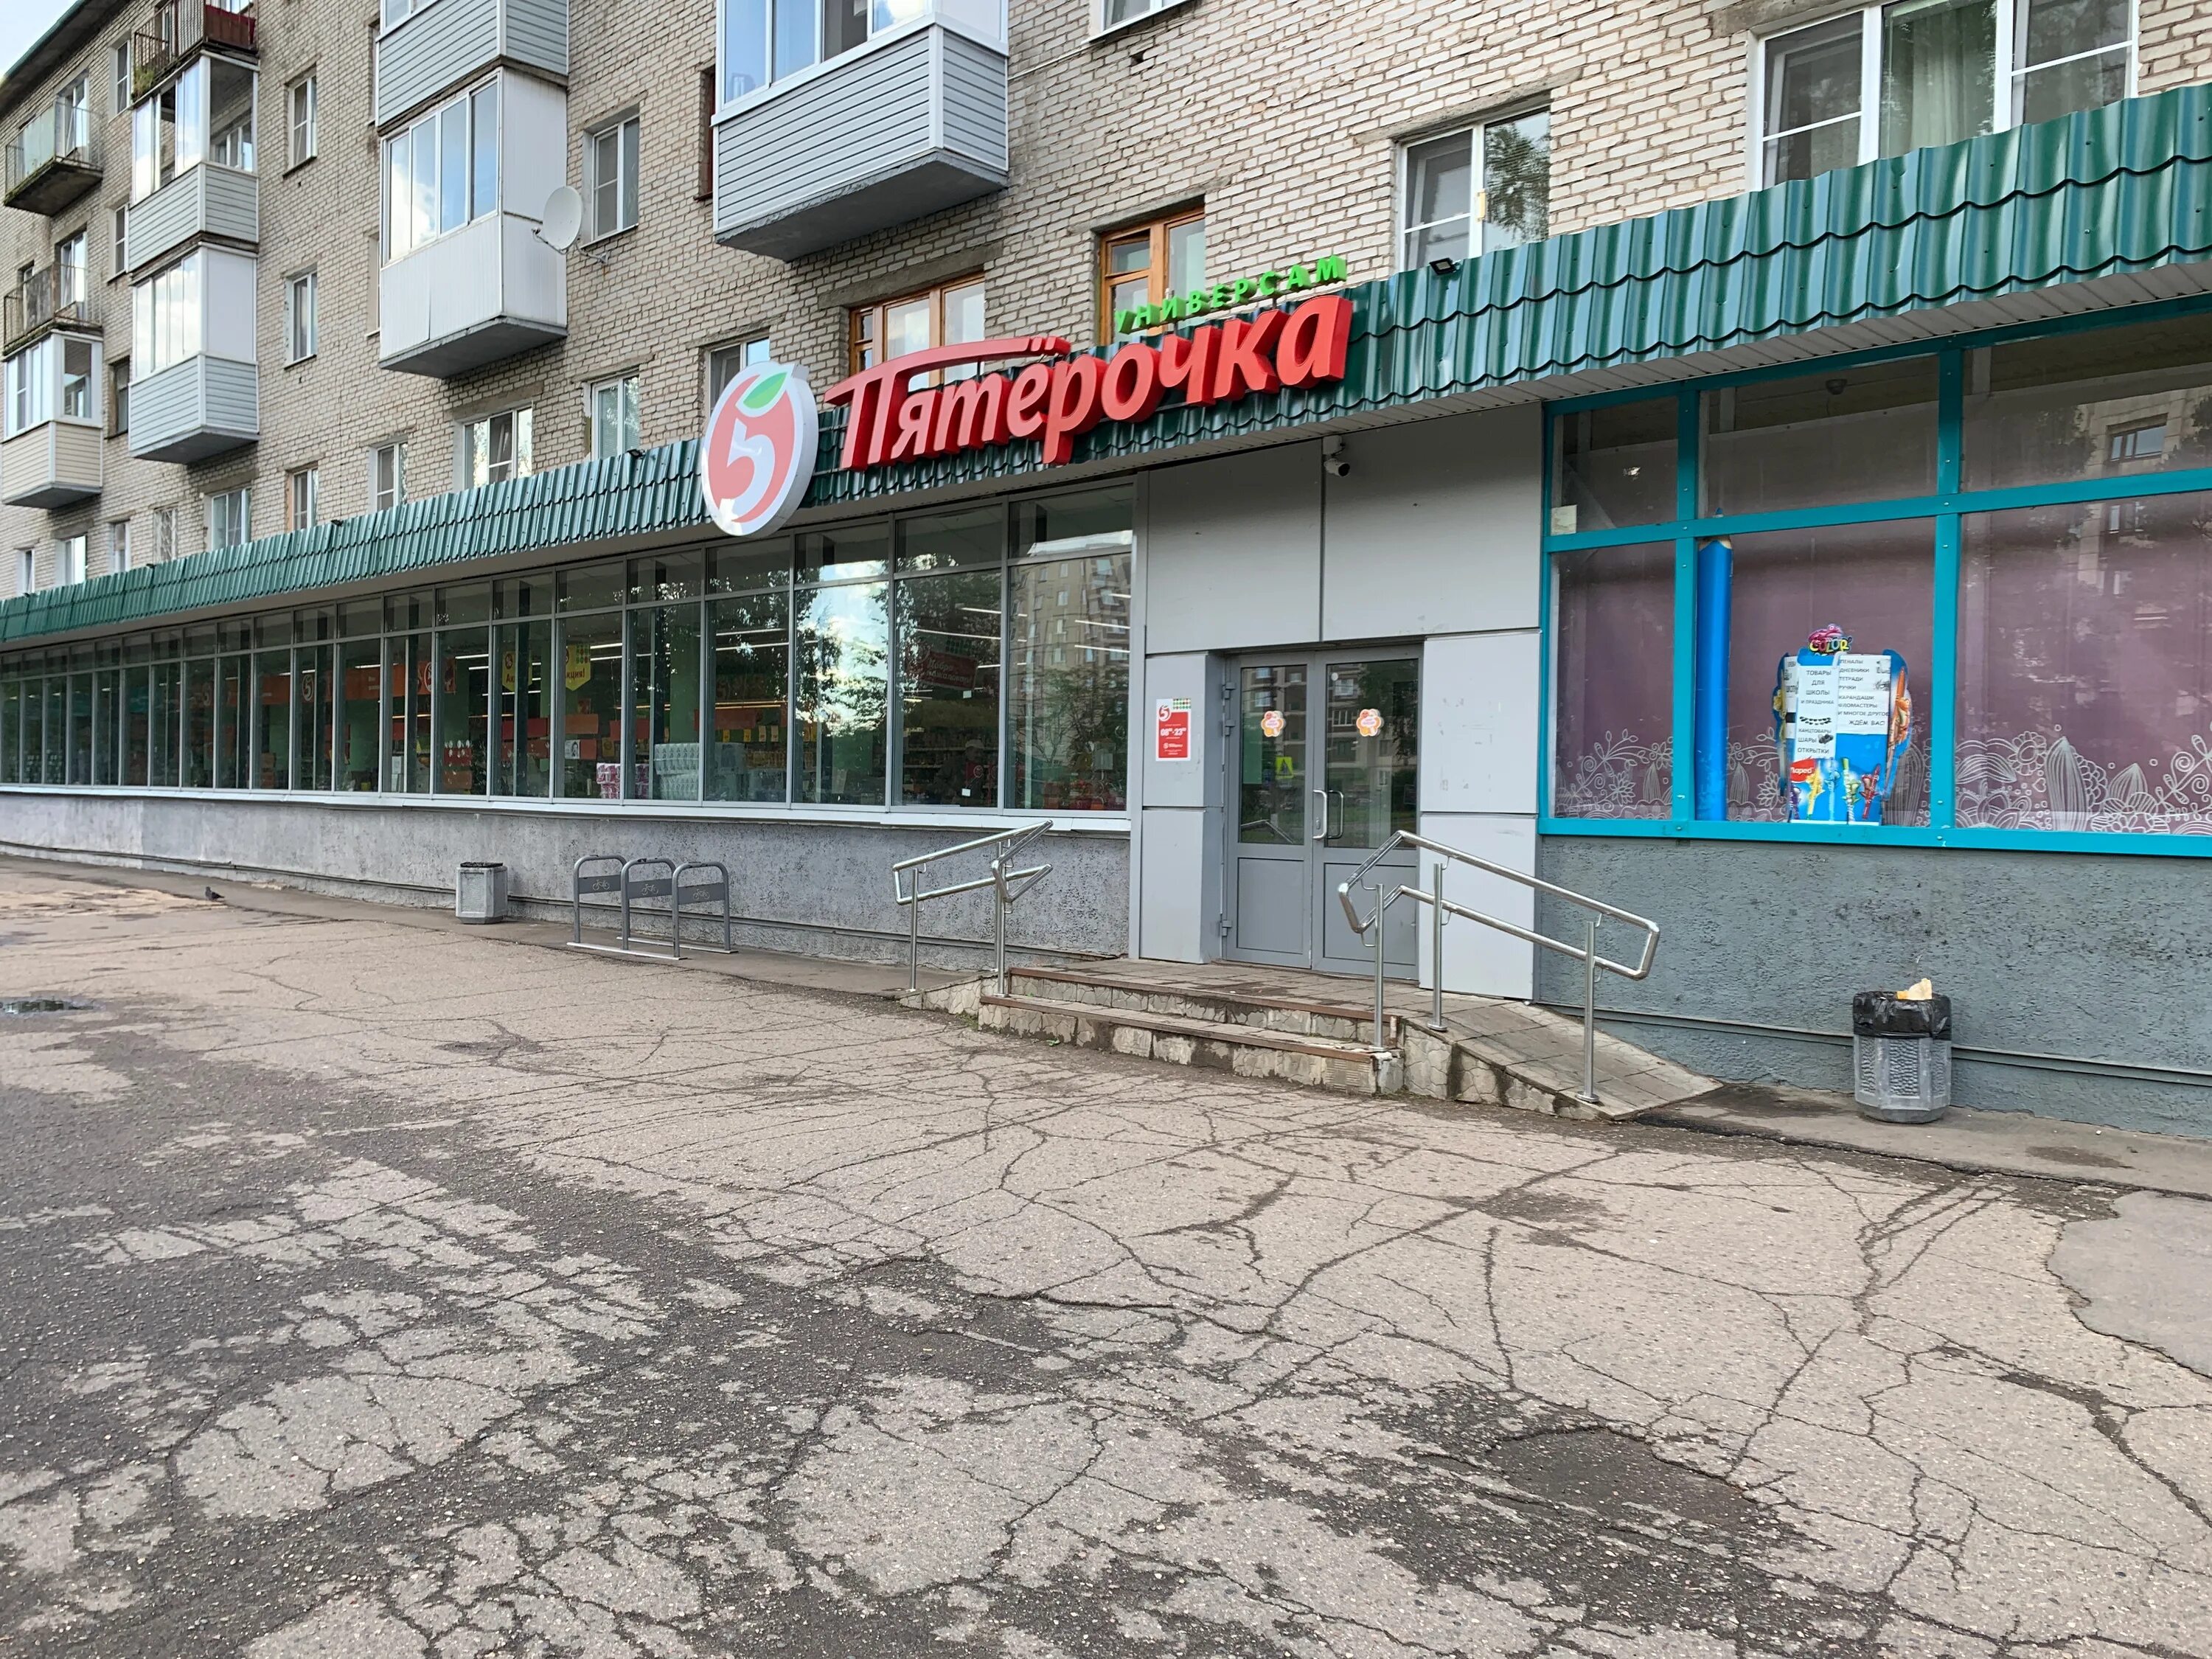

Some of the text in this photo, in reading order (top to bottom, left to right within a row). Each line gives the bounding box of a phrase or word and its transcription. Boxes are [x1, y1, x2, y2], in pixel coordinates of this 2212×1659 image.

[1114, 254, 1346, 334] УНИВЕРСАМ
[824, 295, 1353, 470] Пятёрочка
[566, 668, 585, 680] кция!
